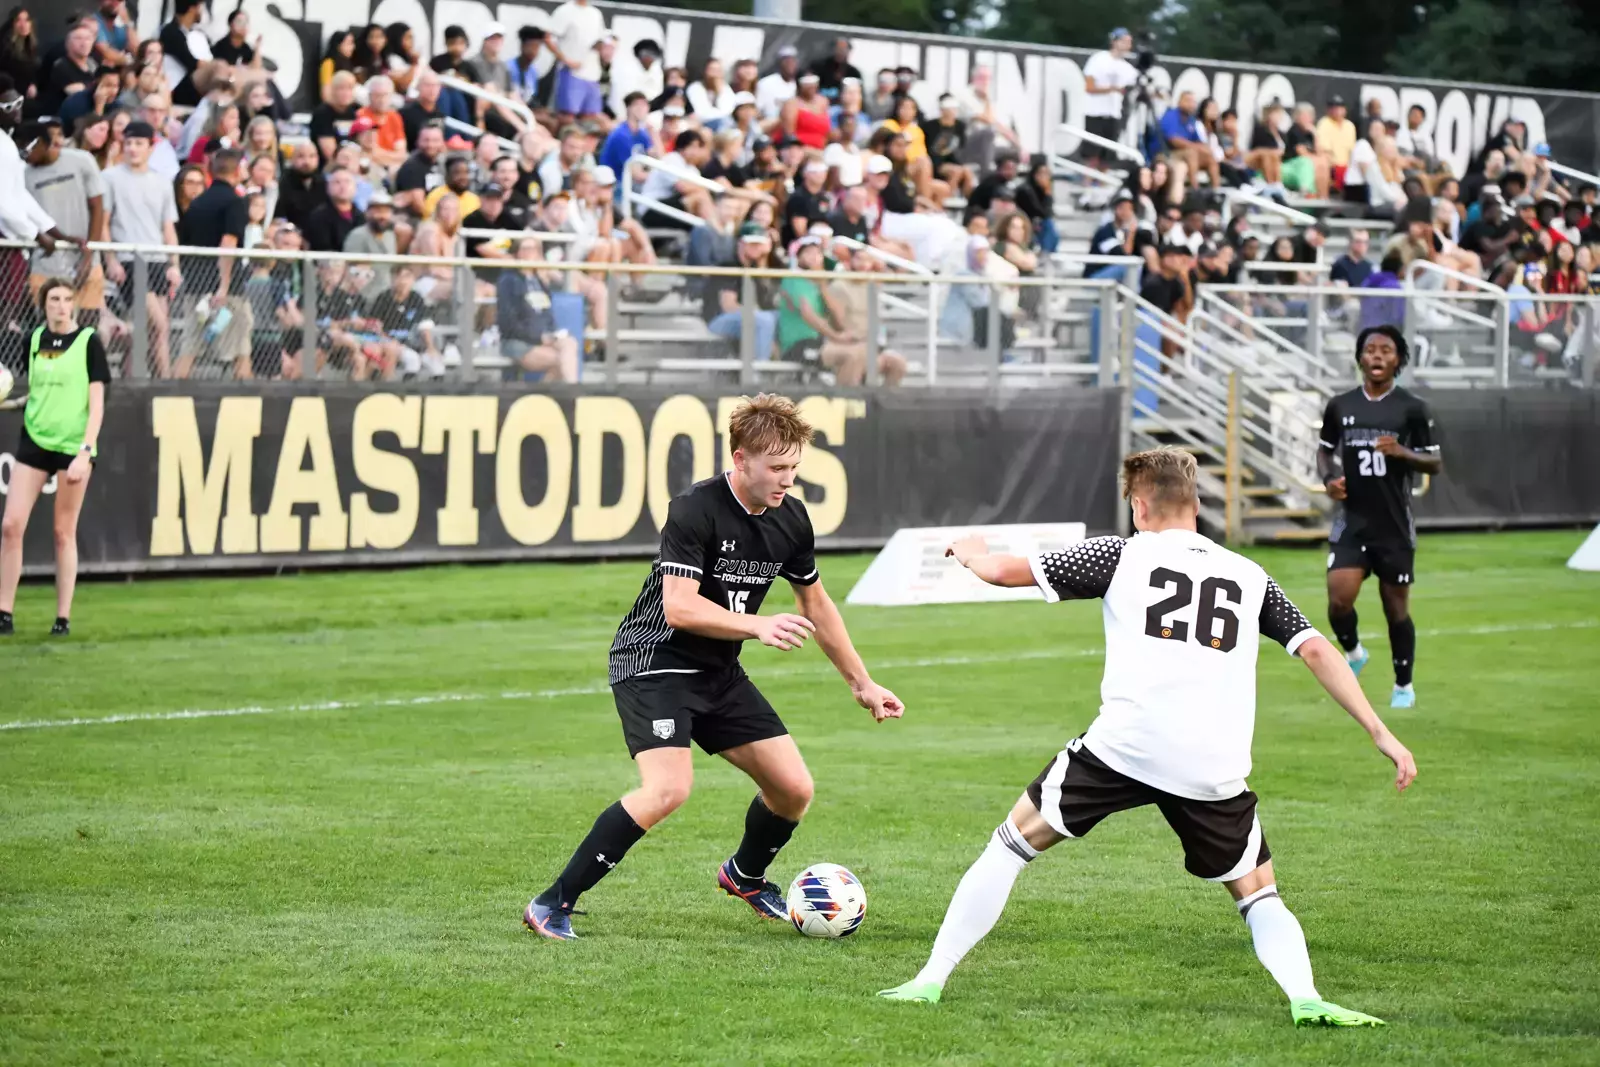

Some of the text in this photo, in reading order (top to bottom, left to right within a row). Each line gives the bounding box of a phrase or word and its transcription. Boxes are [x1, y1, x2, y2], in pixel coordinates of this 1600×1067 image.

[1358, 450, 1387, 477] 20
[714, 558, 783, 577] PURDUE
[722, 573, 741, 584] FORT
[1145, 567, 1242, 653] 26
